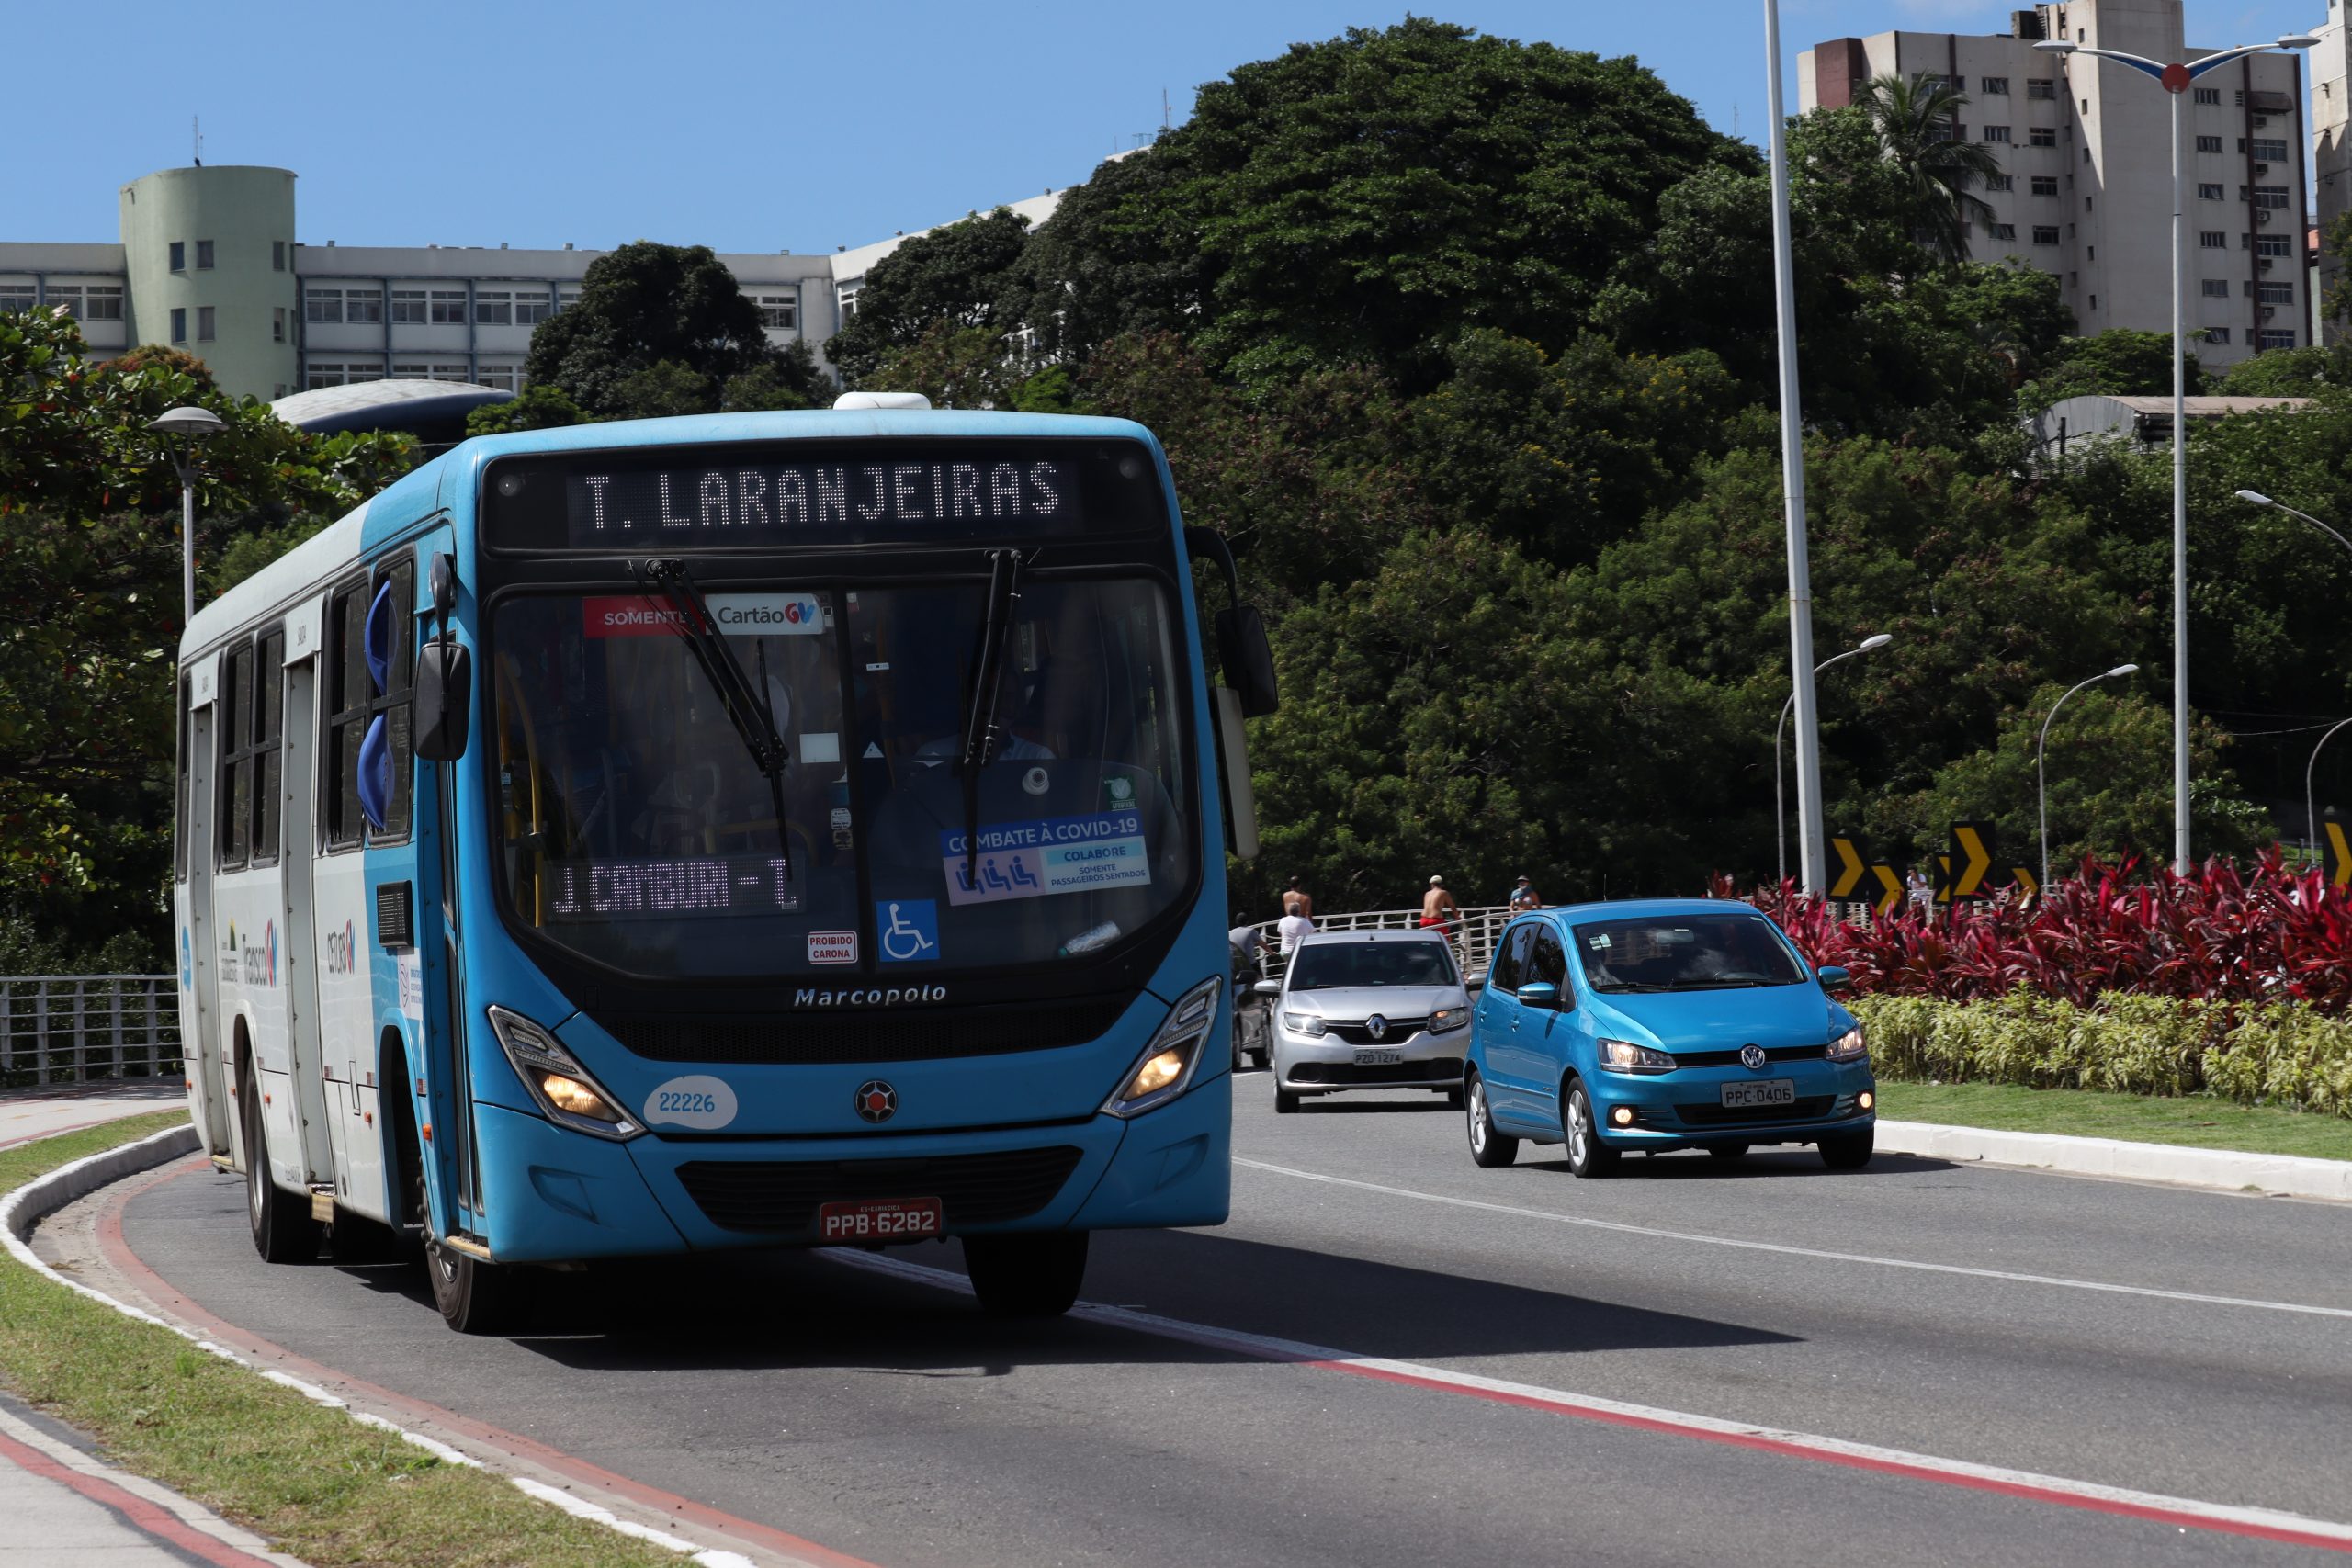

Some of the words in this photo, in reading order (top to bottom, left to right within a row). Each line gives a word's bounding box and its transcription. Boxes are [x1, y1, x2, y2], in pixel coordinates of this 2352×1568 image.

[586, 476, 631, 528] T.
[660, 461, 1058, 527] LARANJEIRAS
[949, 829, 1037, 852] COMBATE
[1041, 822, 1054, 842] À
[1057, 817, 1138, 841] COVID-19
[1064, 846, 1126, 862] COLABORE
[1050, 871, 1105, 886] PASSAGEIROS
[1105, 869, 1147, 882] SENTADOS
[1079, 863, 1117, 874] SOMENTE
[588, 861, 729, 910] CAMBURI
[809, 936, 853, 946] PROIBIDO
[812, 949, 851, 959] CARONA
[794, 984, 947, 1007] Marcopolo
[659, 1092, 716, 1112] 22226
